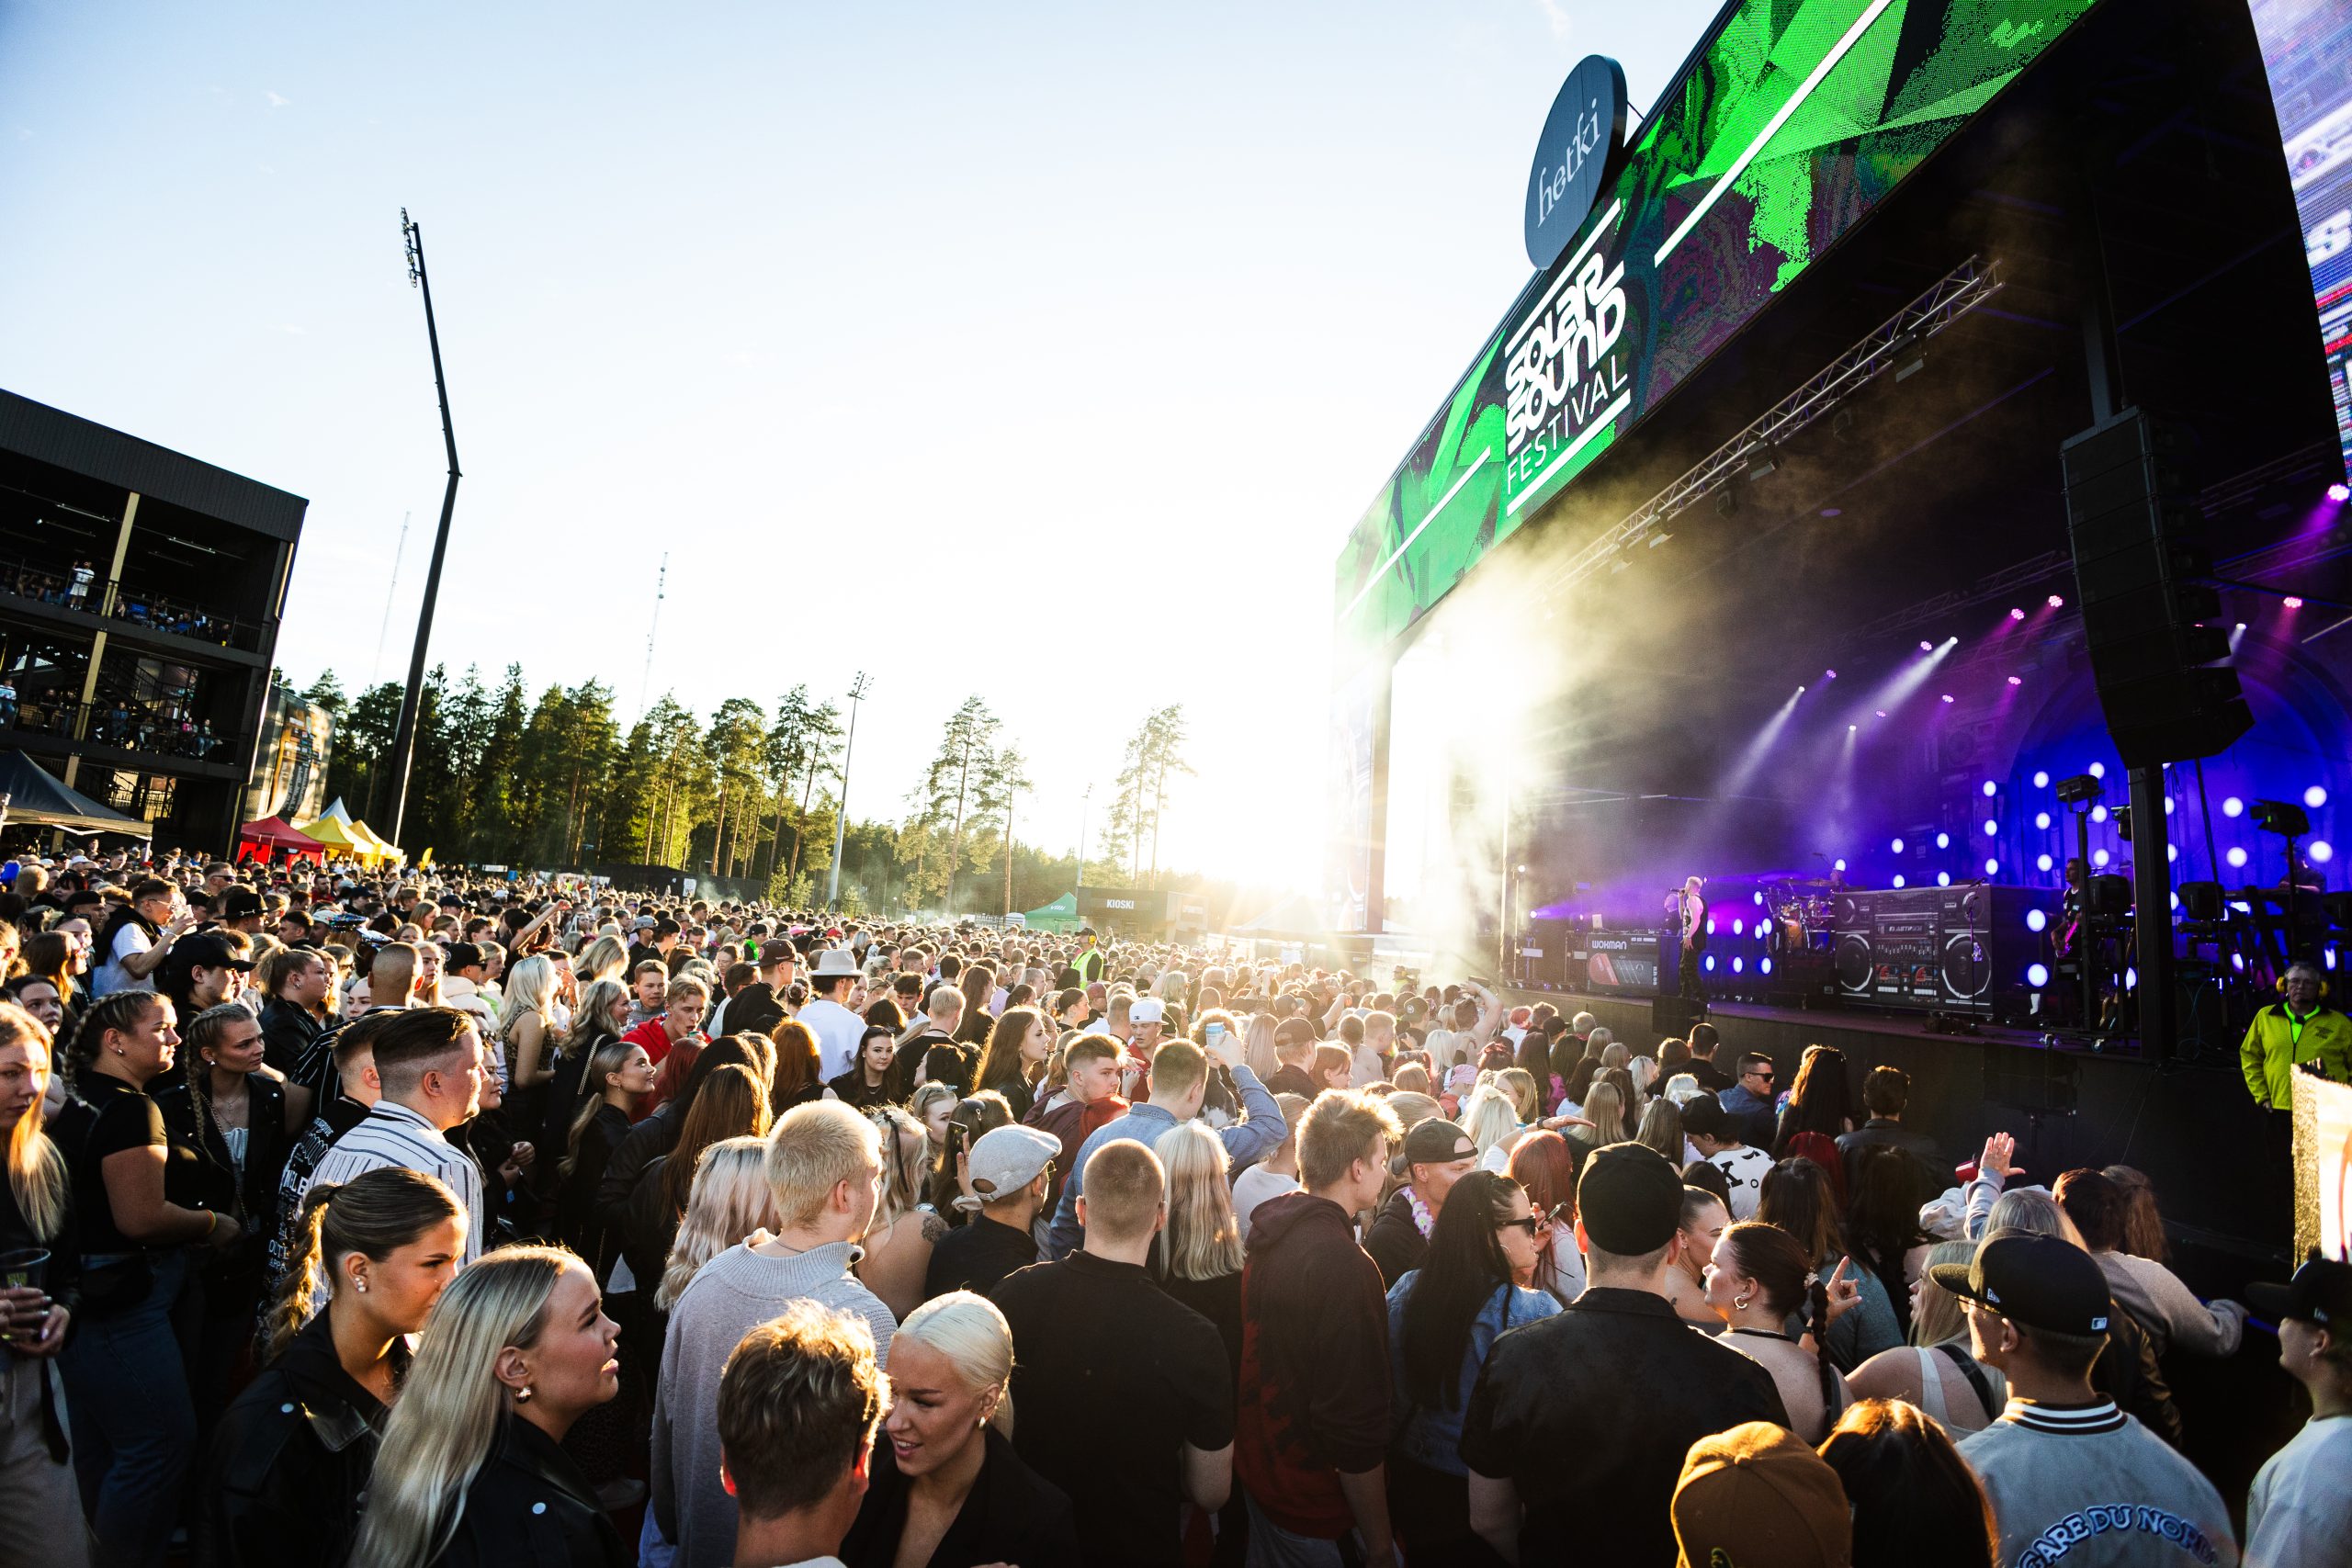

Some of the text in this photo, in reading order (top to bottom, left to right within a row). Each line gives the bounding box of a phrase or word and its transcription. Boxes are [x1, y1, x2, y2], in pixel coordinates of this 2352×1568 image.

[1538, 97, 1600, 229] hetki
[1505, 253, 1625, 411] SOLAR
[1505, 287, 1626, 456] SOUND
[1507, 355, 1628, 495] FESTIVAL
[1106, 899, 1135, 909] KIOSKI
[1591, 940, 1627, 950] WOKMAN
[2017, 1511, 2093, 1568] GARE
[2086, 1504, 2132, 1535] DU
